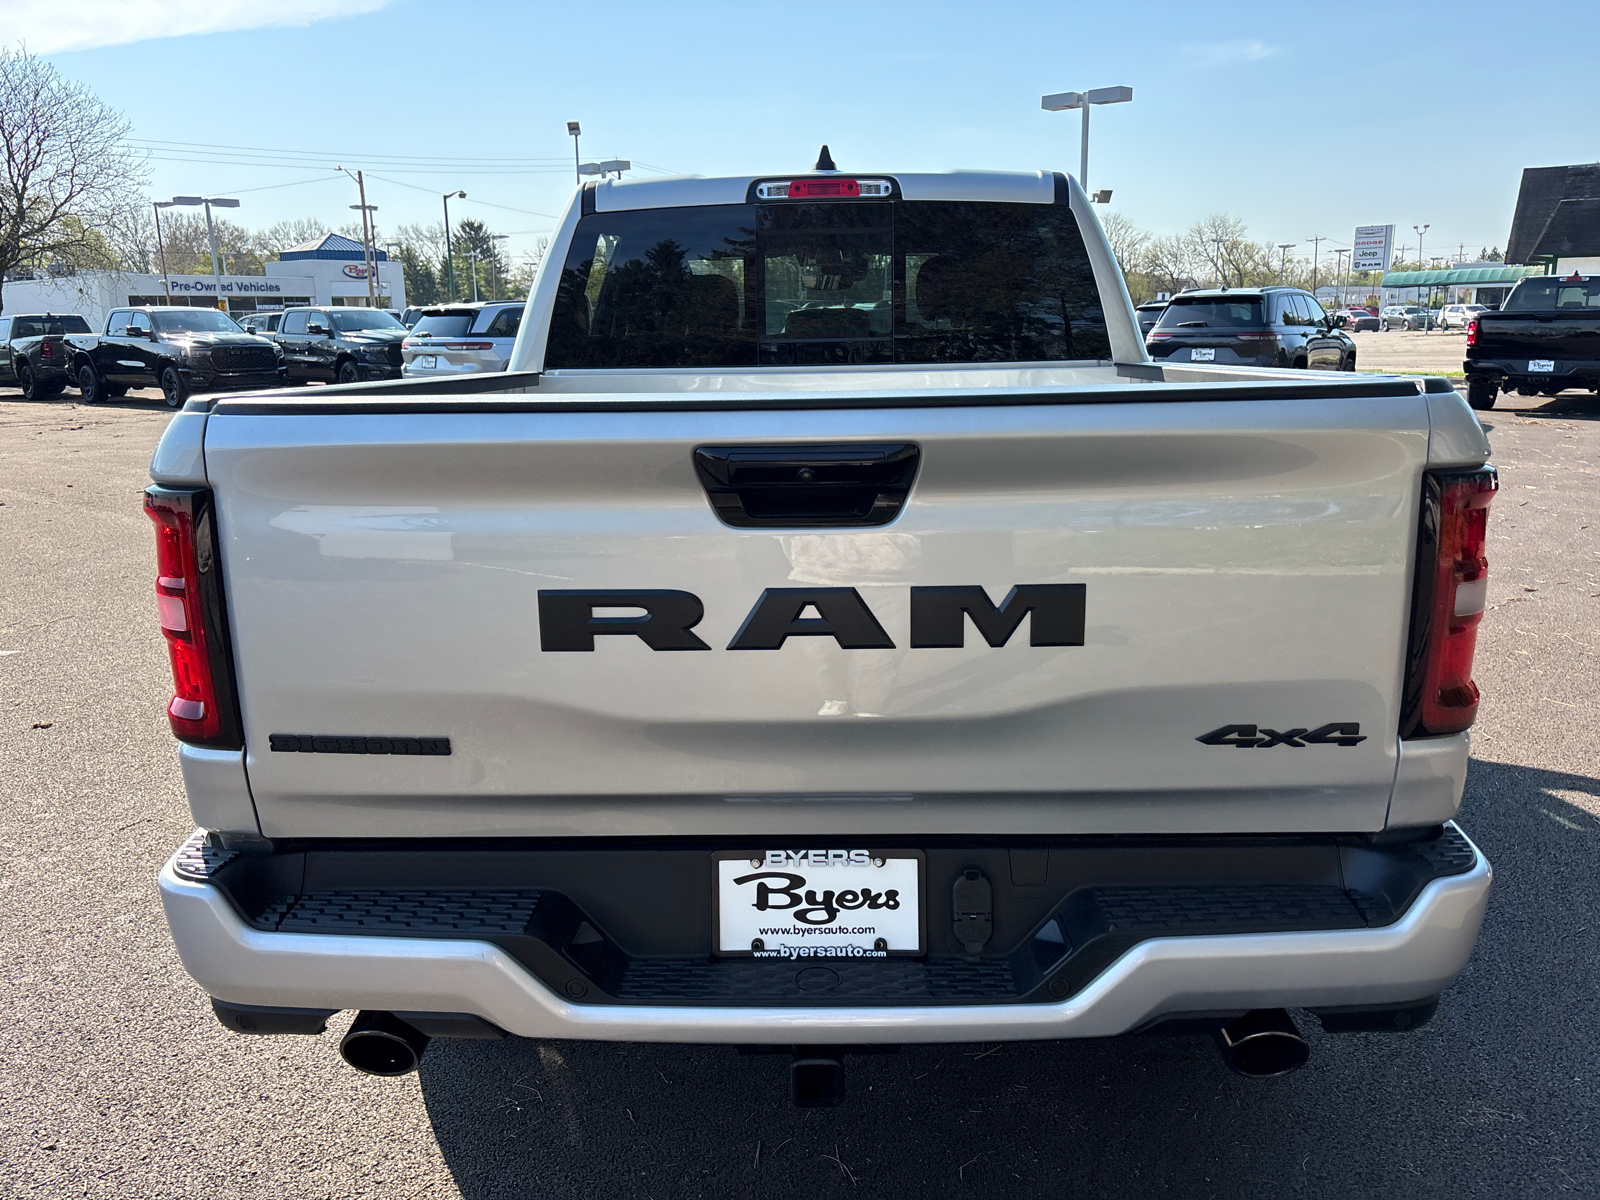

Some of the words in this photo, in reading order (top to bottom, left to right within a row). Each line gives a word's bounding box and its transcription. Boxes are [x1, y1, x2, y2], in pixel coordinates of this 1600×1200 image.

[1359, 250, 1378, 258] Jeep
[236, 281, 281, 292] Vehicles
[537, 583, 1087, 652] RAM
[1195, 722, 1368, 748] 4x4
[765, 849, 870, 868] BYERS
[732, 871, 901, 925] Byers
[759, 925, 876, 937] www.byersauto.com
[753, 943, 887, 960] www.byersauto.com
